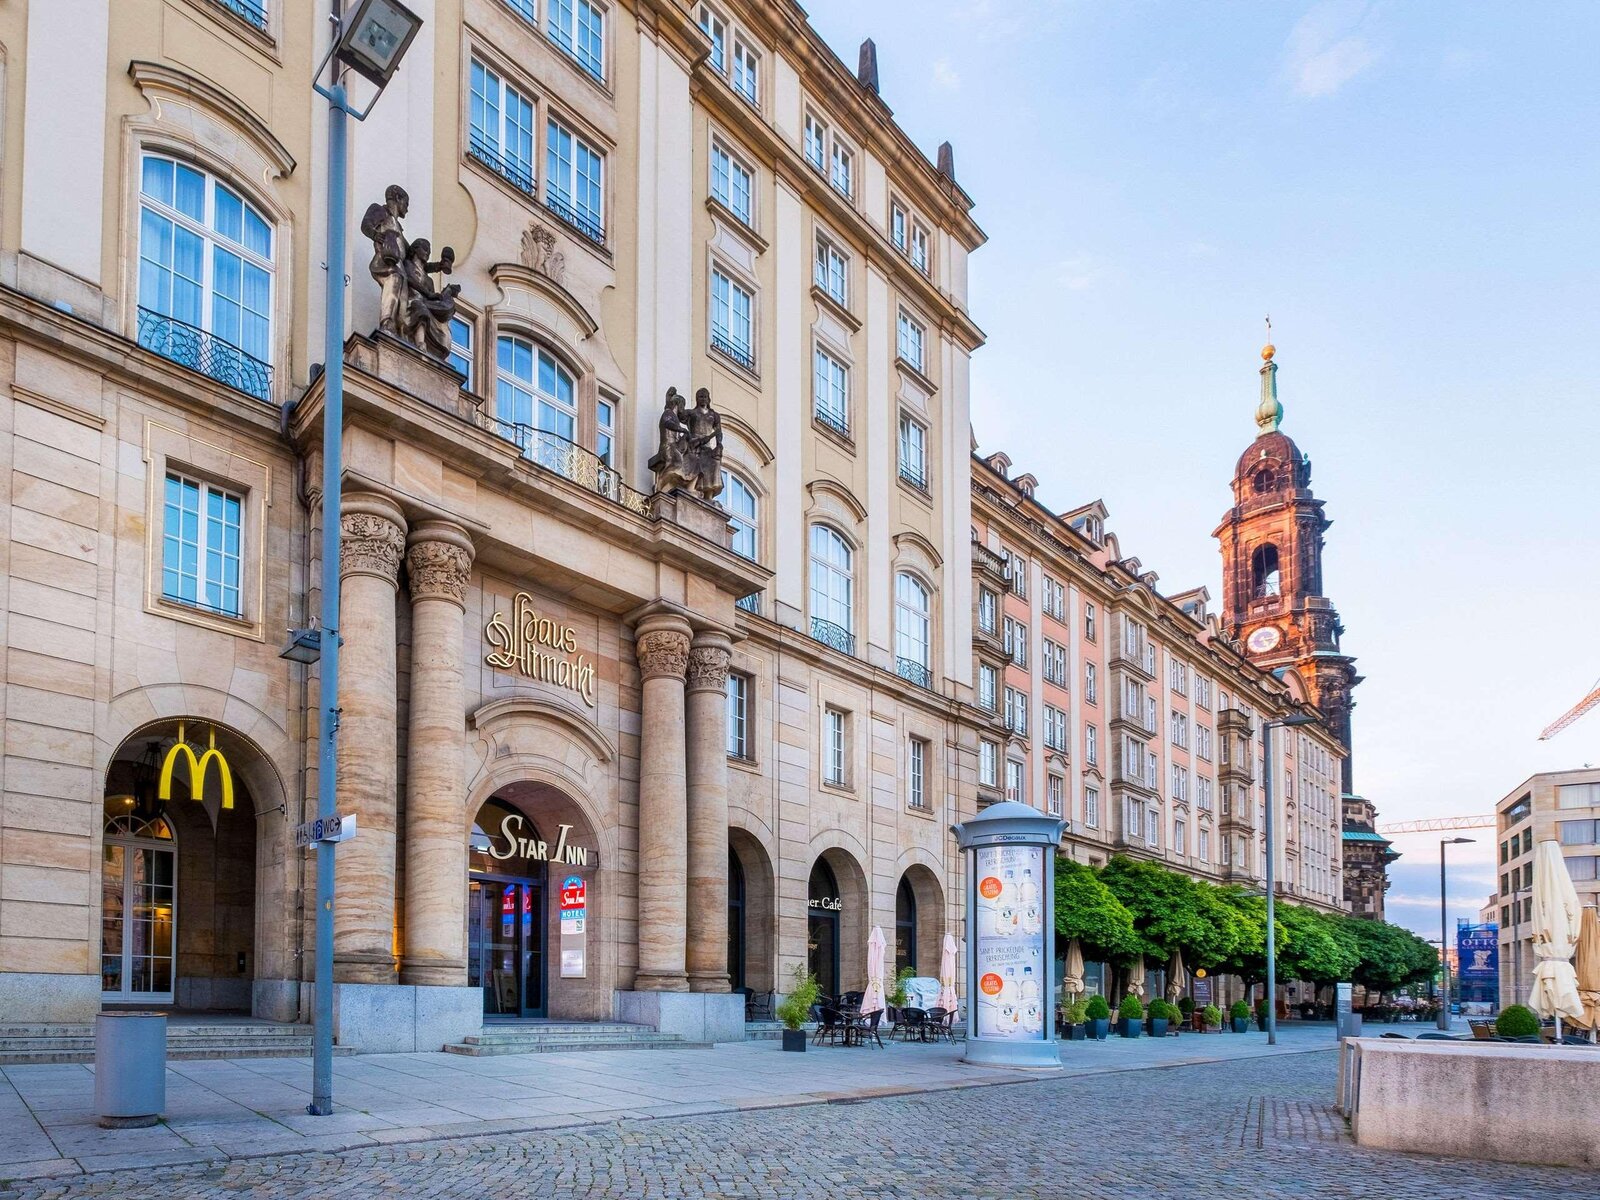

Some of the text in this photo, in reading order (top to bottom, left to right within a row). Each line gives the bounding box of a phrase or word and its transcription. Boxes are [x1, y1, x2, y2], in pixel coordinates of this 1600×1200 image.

[323, 819, 335, 834] WC
[821, 897, 842, 911] Café
[562, 910, 584, 918] HOTEL
[1461, 938, 1498, 946] OTTO
